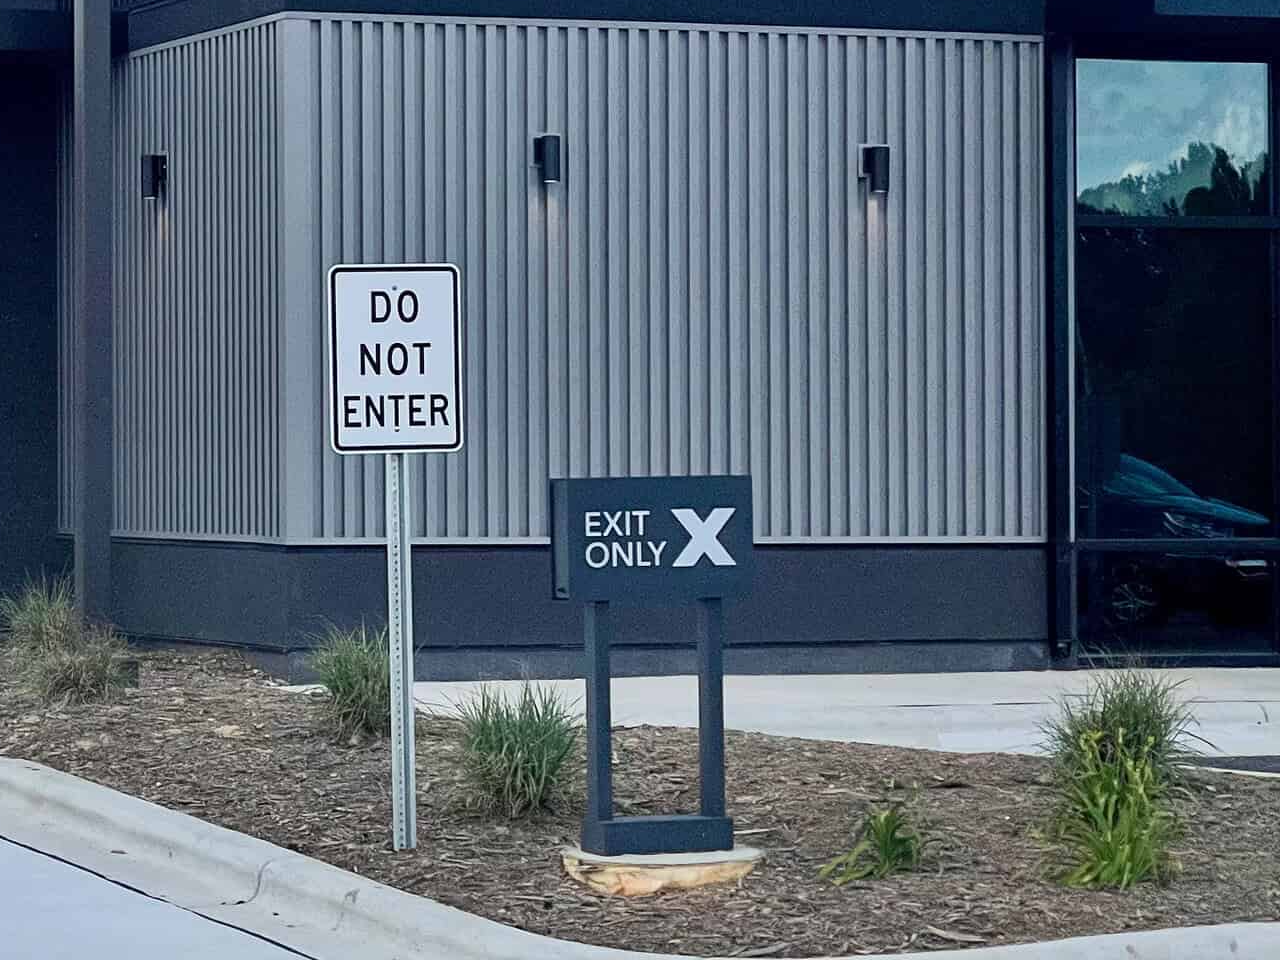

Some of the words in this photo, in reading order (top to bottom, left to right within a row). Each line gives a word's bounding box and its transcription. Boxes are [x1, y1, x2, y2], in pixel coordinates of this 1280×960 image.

[369, 289, 420, 325] DO
[358, 341, 433, 377] NOT
[342, 393, 451, 429] ENTER
[584, 510, 651, 538] EXIT
[584, 540, 668, 570] ONLY
